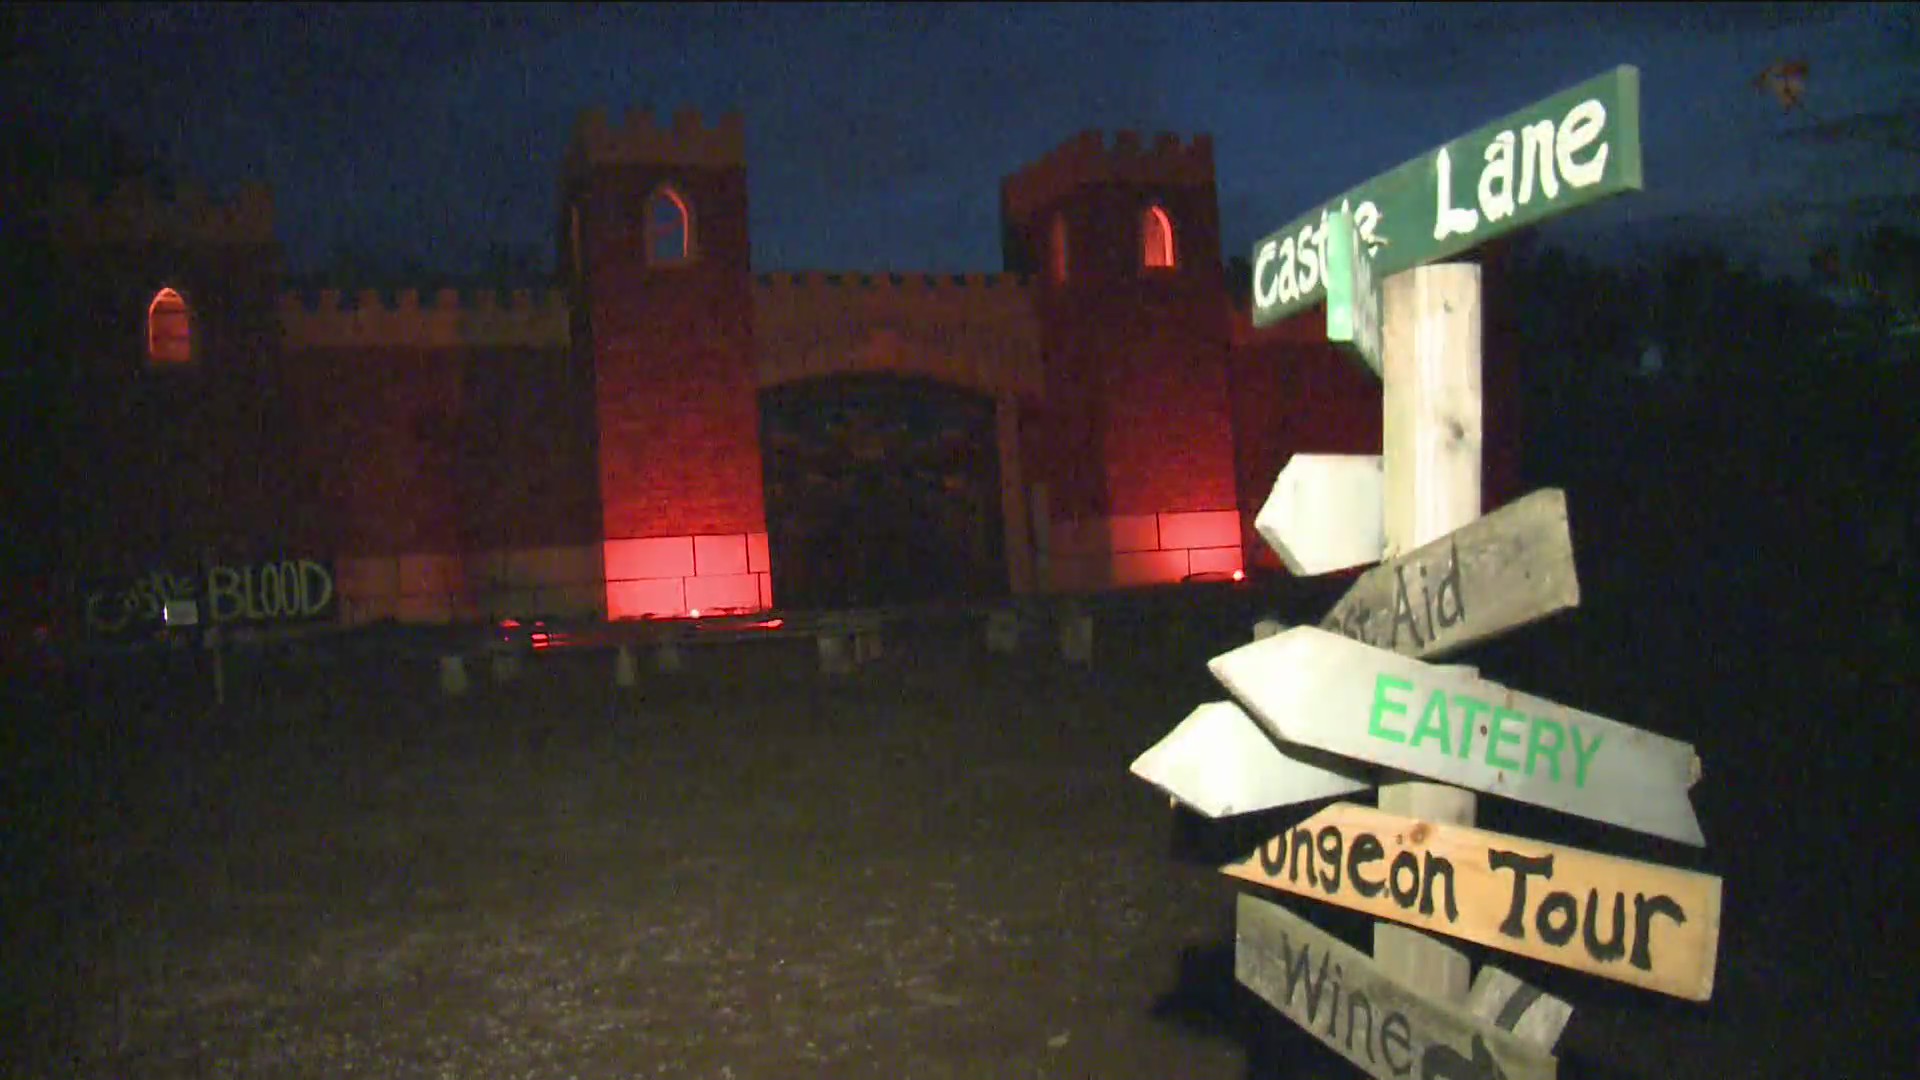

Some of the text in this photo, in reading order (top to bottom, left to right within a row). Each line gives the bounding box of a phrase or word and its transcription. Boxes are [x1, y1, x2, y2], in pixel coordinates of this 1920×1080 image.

[1434, 98, 1609, 241] Lane
[208, 560, 333, 623] BLOOD
[1391, 533, 1465, 651] Aid
[1367, 673, 1605, 789] EATERY
[1488, 848, 1688, 972] Tour
[1281, 933, 1413, 1076] Wine
